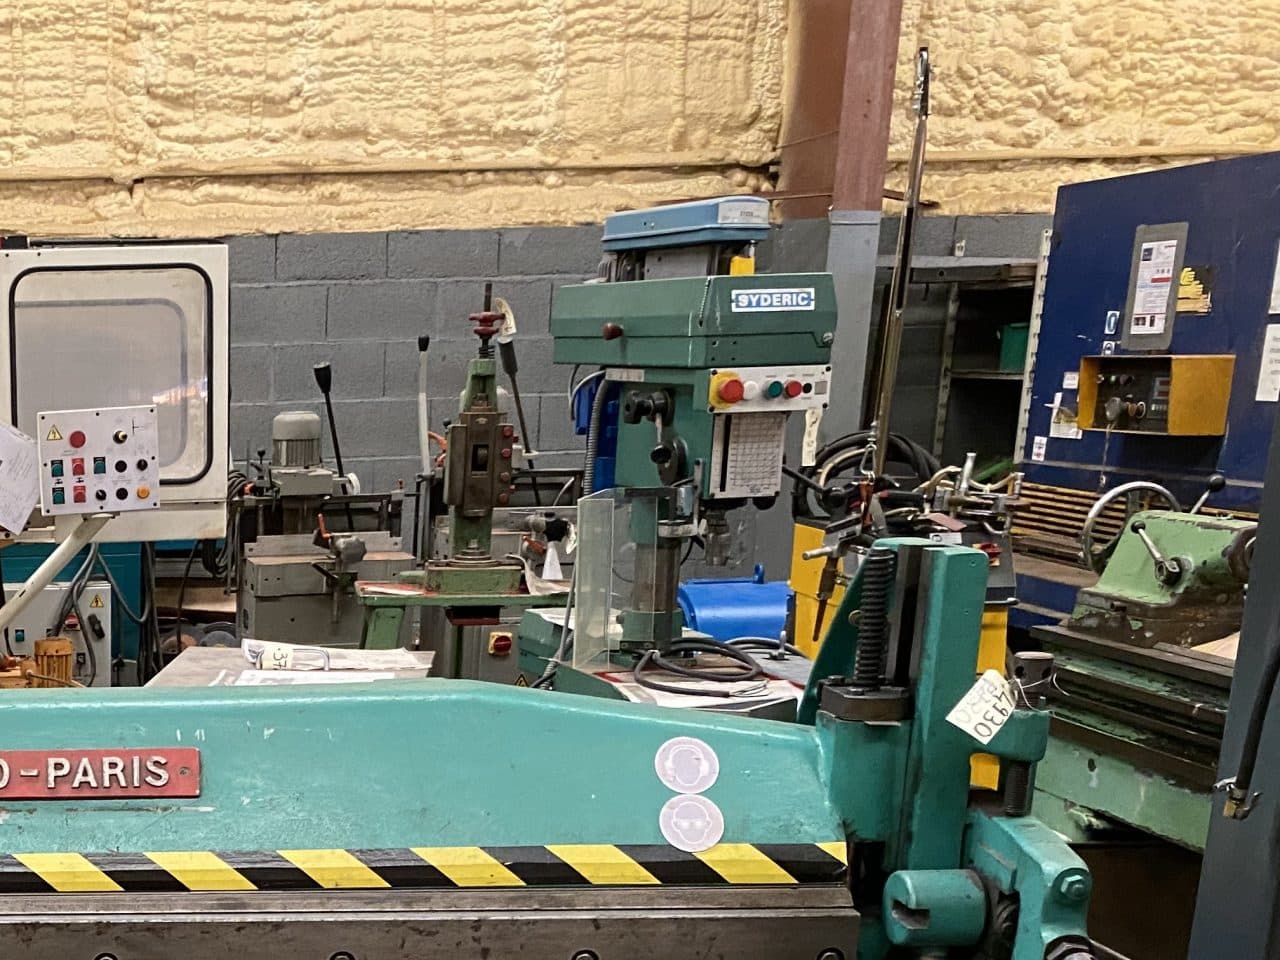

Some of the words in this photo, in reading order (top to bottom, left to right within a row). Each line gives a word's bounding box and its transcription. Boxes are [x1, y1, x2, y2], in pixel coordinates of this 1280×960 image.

[738, 293, 809, 307] SYDERIC
[974, 690, 1014, 738] 4930
[47, 755, 171, 789] PARIS
